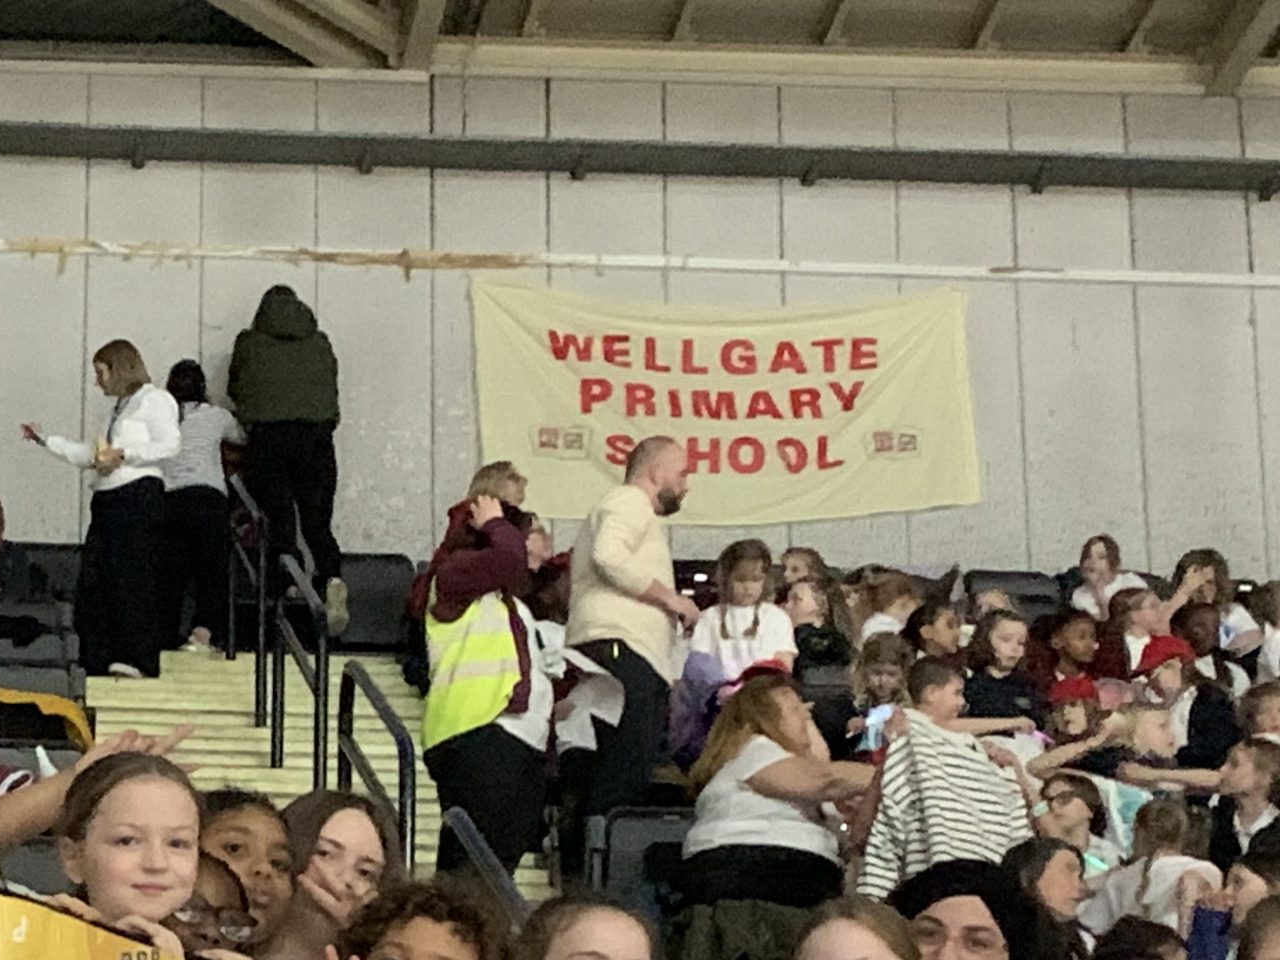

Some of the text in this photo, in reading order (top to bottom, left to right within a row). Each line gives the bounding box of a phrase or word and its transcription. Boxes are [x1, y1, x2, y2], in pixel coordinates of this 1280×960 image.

[548, 329, 878, 375] WELLGATE
[579, 377, 865, 420] PRIMARY
[605, 434, 845, 475] SHOOL
